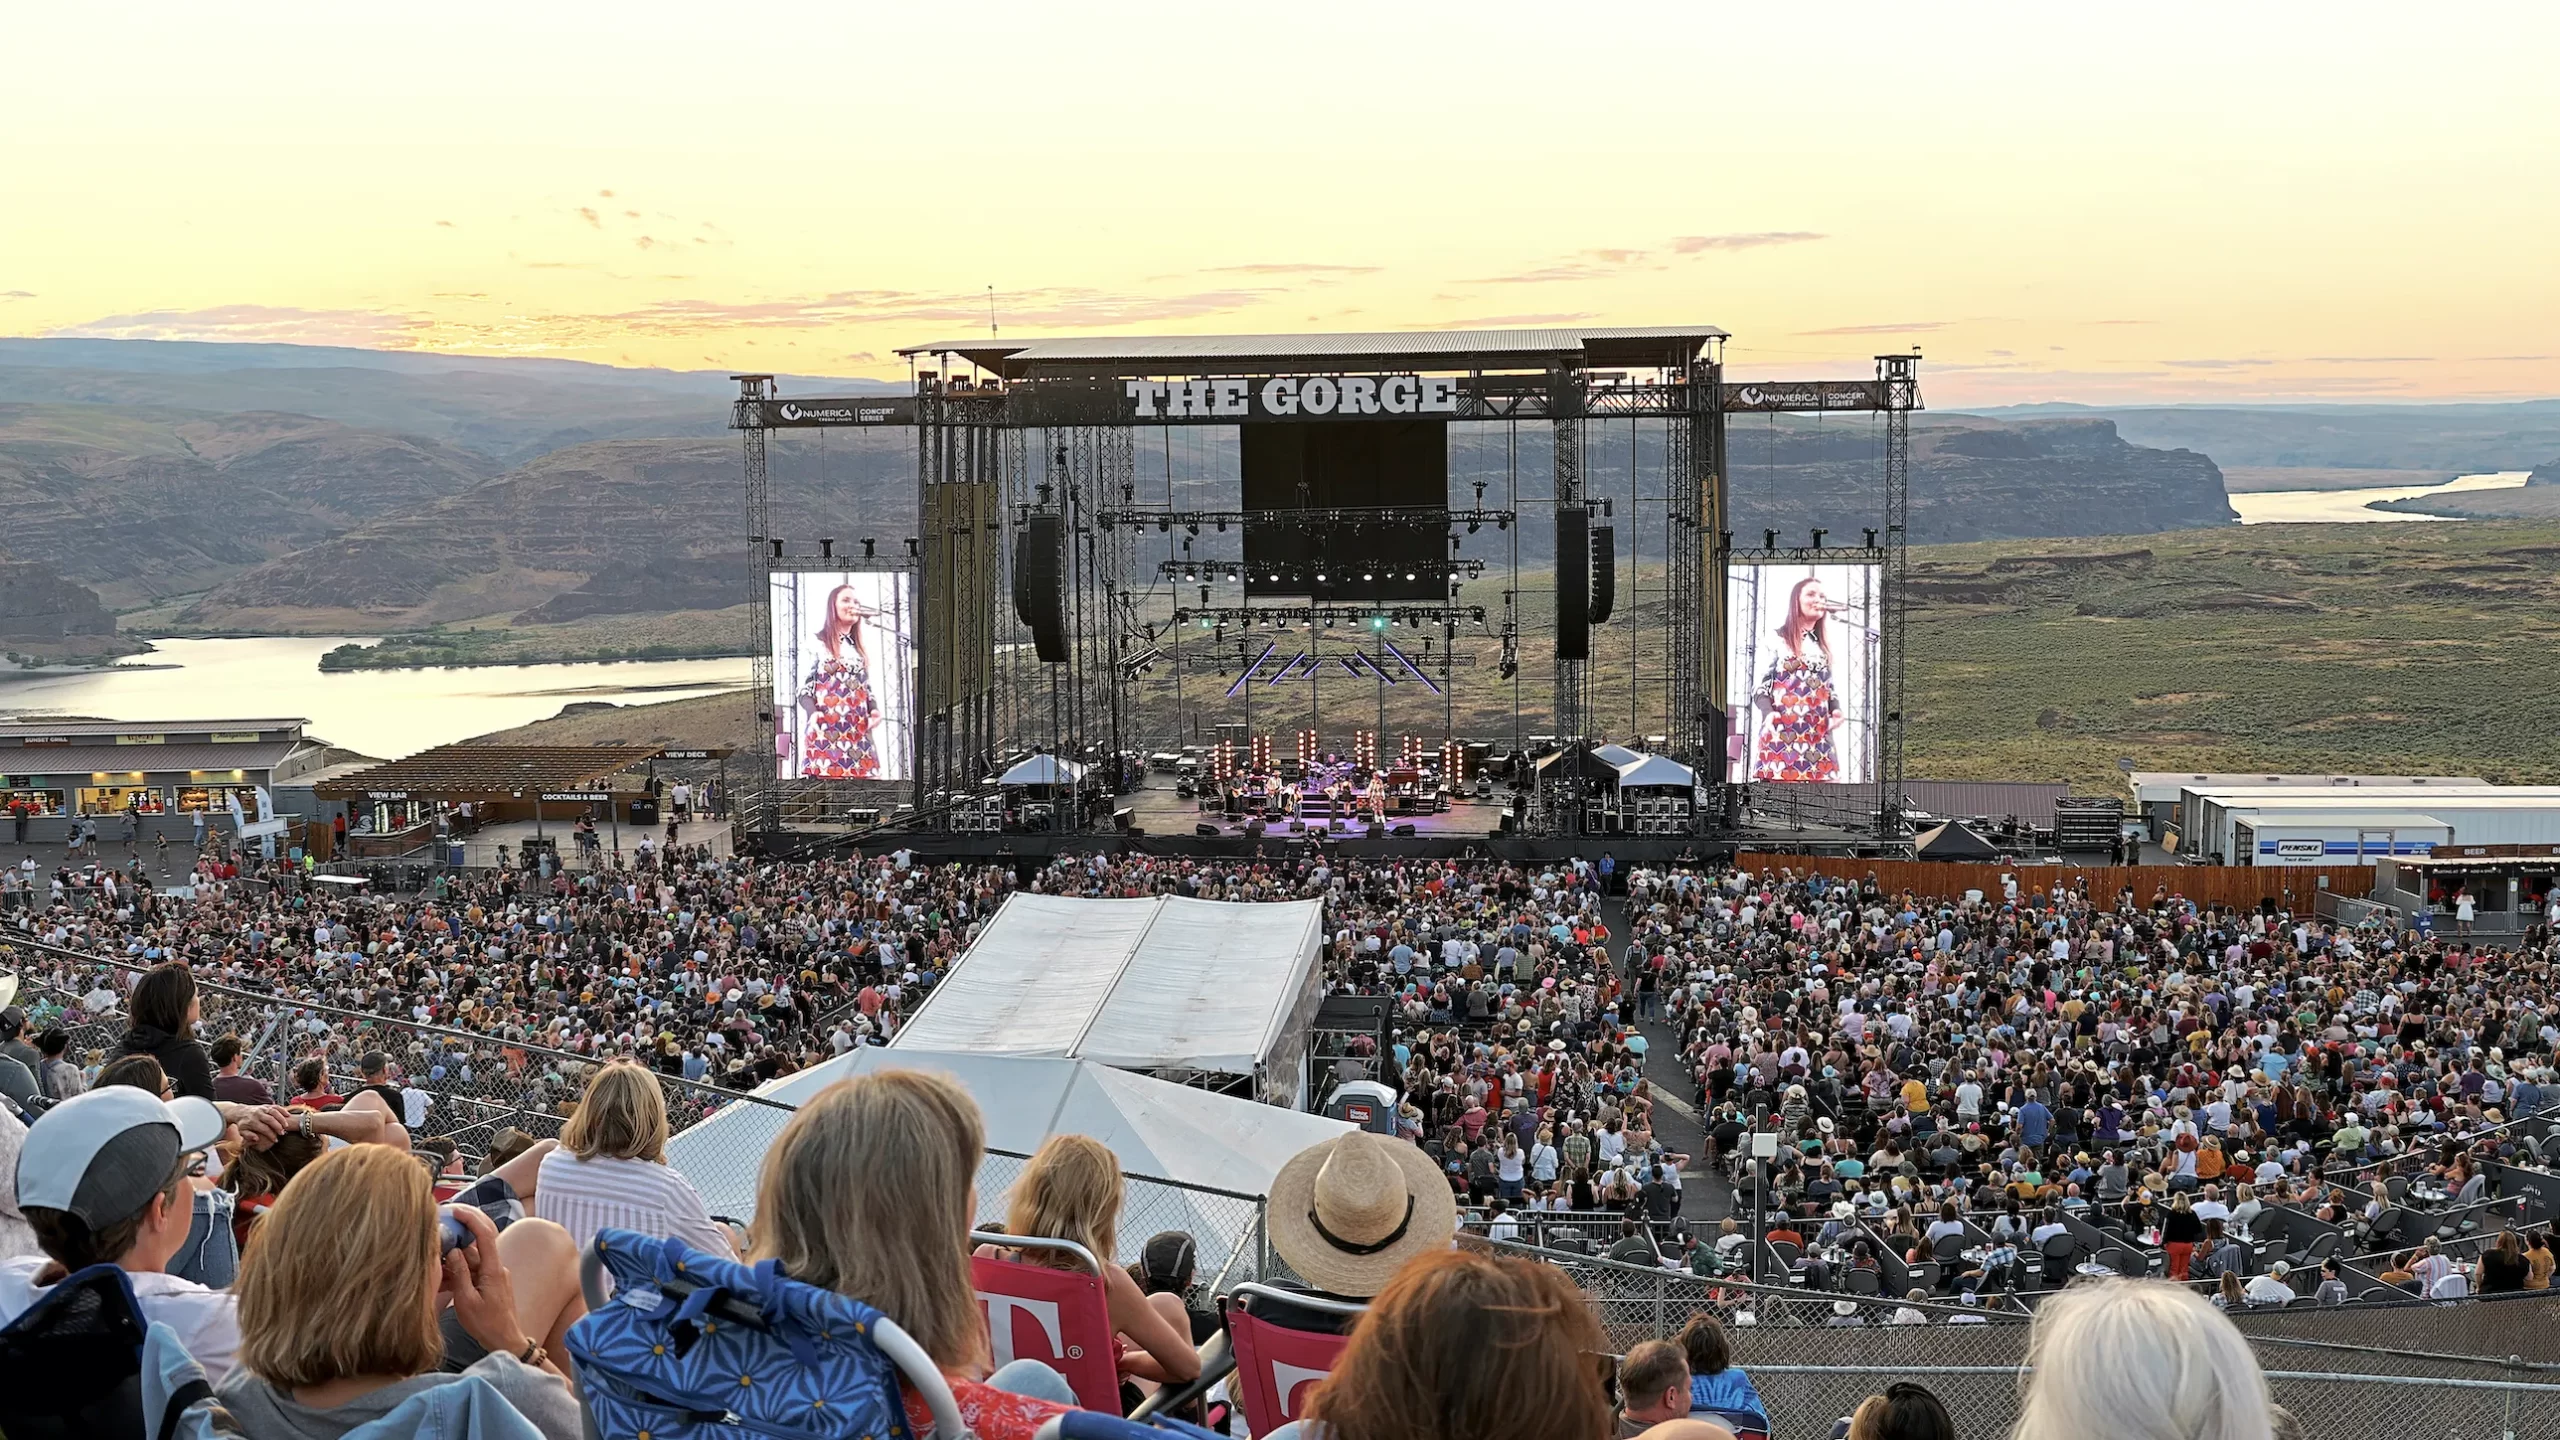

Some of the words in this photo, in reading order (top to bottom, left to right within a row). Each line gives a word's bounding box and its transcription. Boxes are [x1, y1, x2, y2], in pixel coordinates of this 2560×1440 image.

[1126, 380, 1249, 416] THE
[1262, 376, 1456, 415] GORGE
[1765, 393, 1819, 402] NUMERICA
[1827, 392, 1866, 400] CONCERT
[802, 409, 852, 418] NUMERICA
